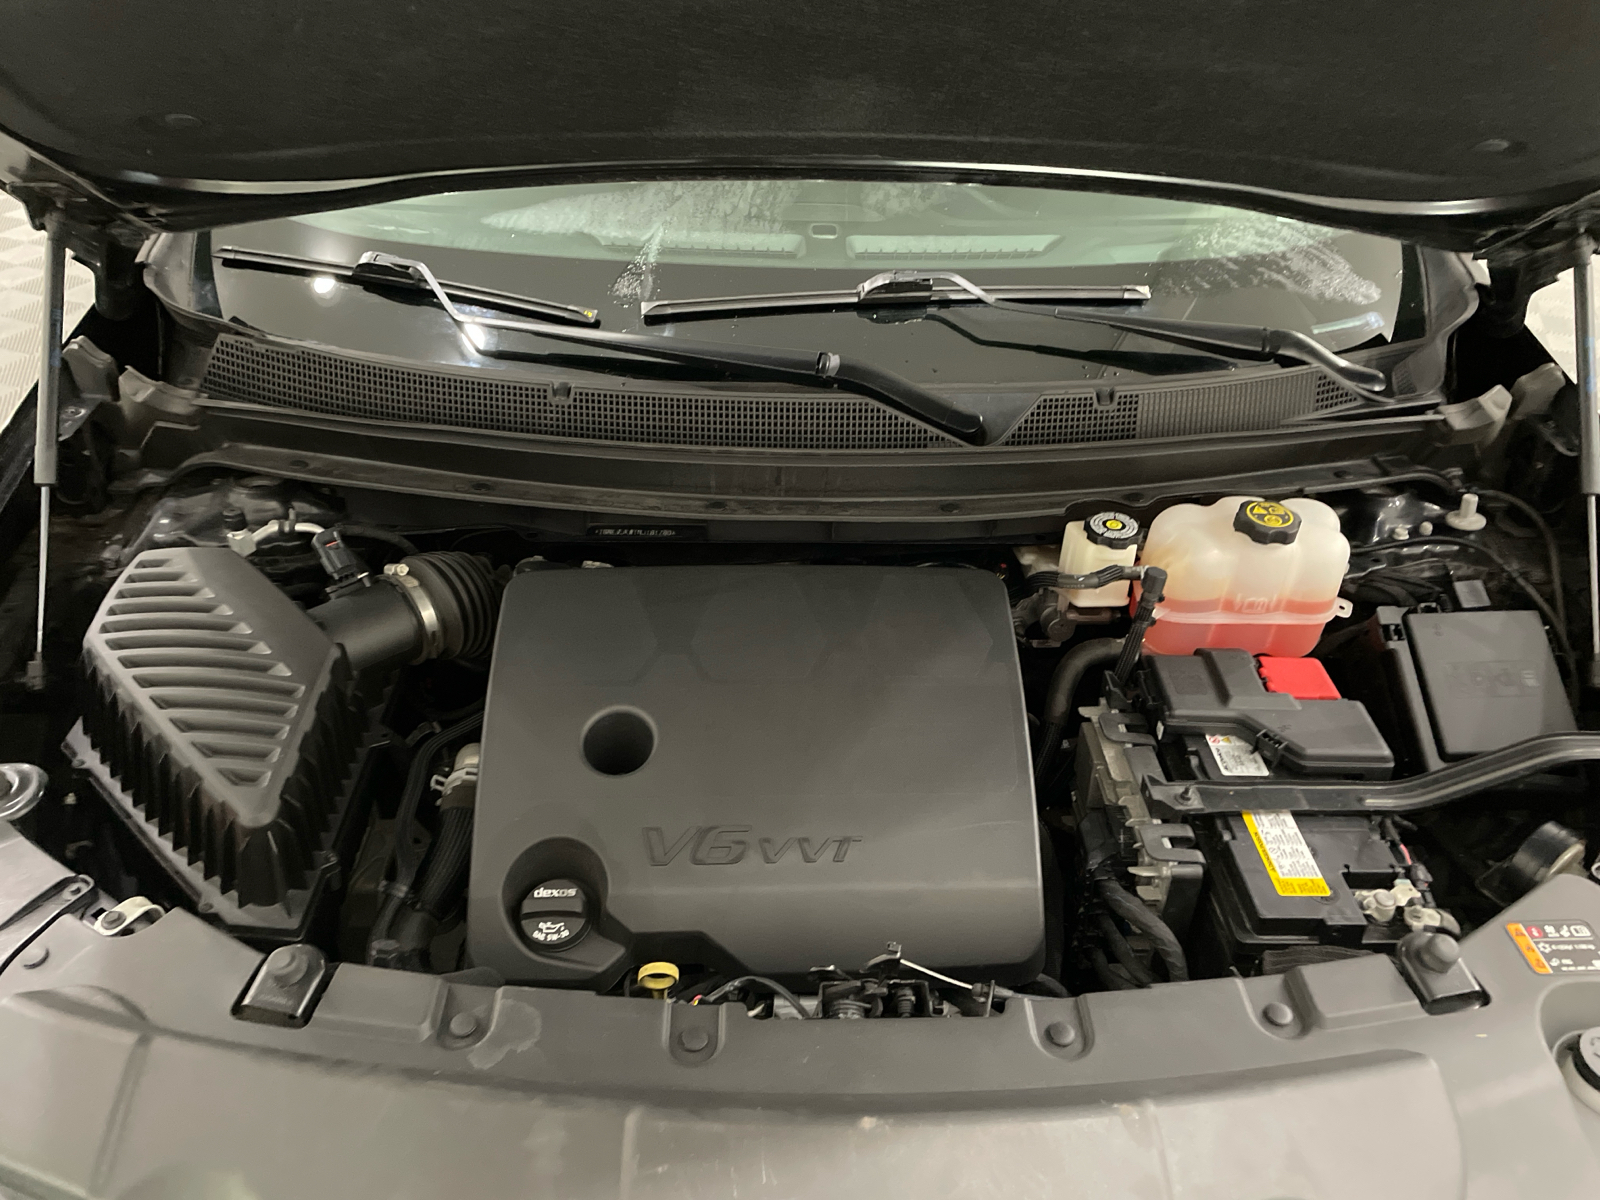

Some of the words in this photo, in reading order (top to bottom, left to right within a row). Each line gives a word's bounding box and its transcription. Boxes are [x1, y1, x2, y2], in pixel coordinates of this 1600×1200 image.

[642, 824, 753, 867] V6
[759, 835, 864, 863] VVT
[533, 886, 579, 899] dexos
